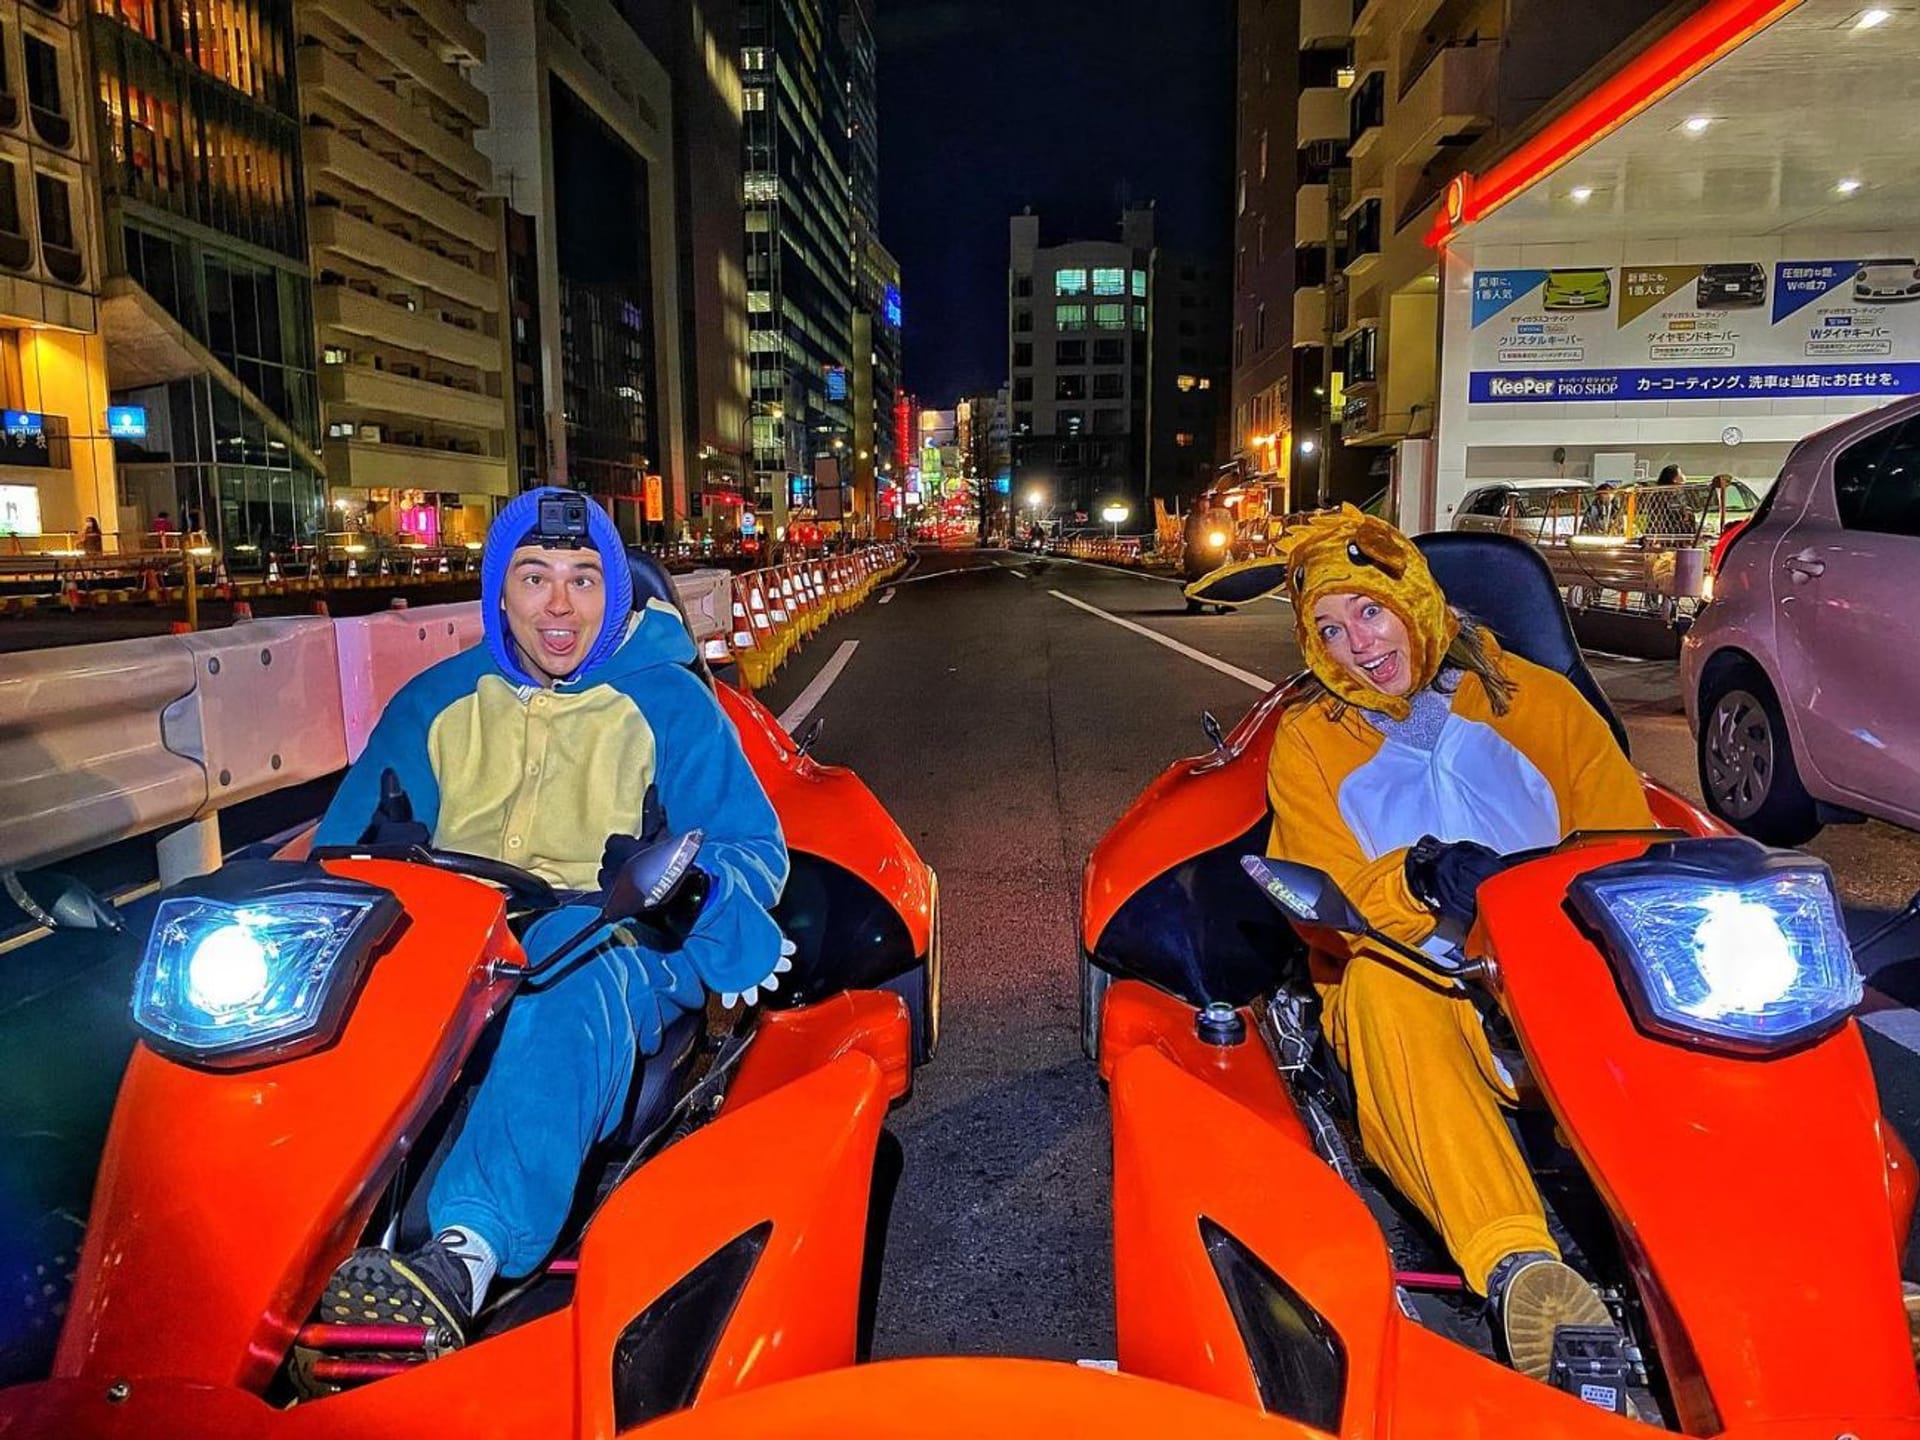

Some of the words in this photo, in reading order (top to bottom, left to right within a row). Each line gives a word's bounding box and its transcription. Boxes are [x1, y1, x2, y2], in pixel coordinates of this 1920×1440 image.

[1648, 331, 1740, 343] ダイヤモンドキーパー
[1810, 327, 1890, 340] Wダイヤキーパー
[1499, 335, 1584, 346] クリスタルキーパー
[1491, 379, 1554, 395] KeePer
[1558, 383, 1583, 395] PRO
[1585, 383, 1619, 395] SHOP
[1637, 372, 1900, 391] カーコーティング、洗車は当店にお任せを。
